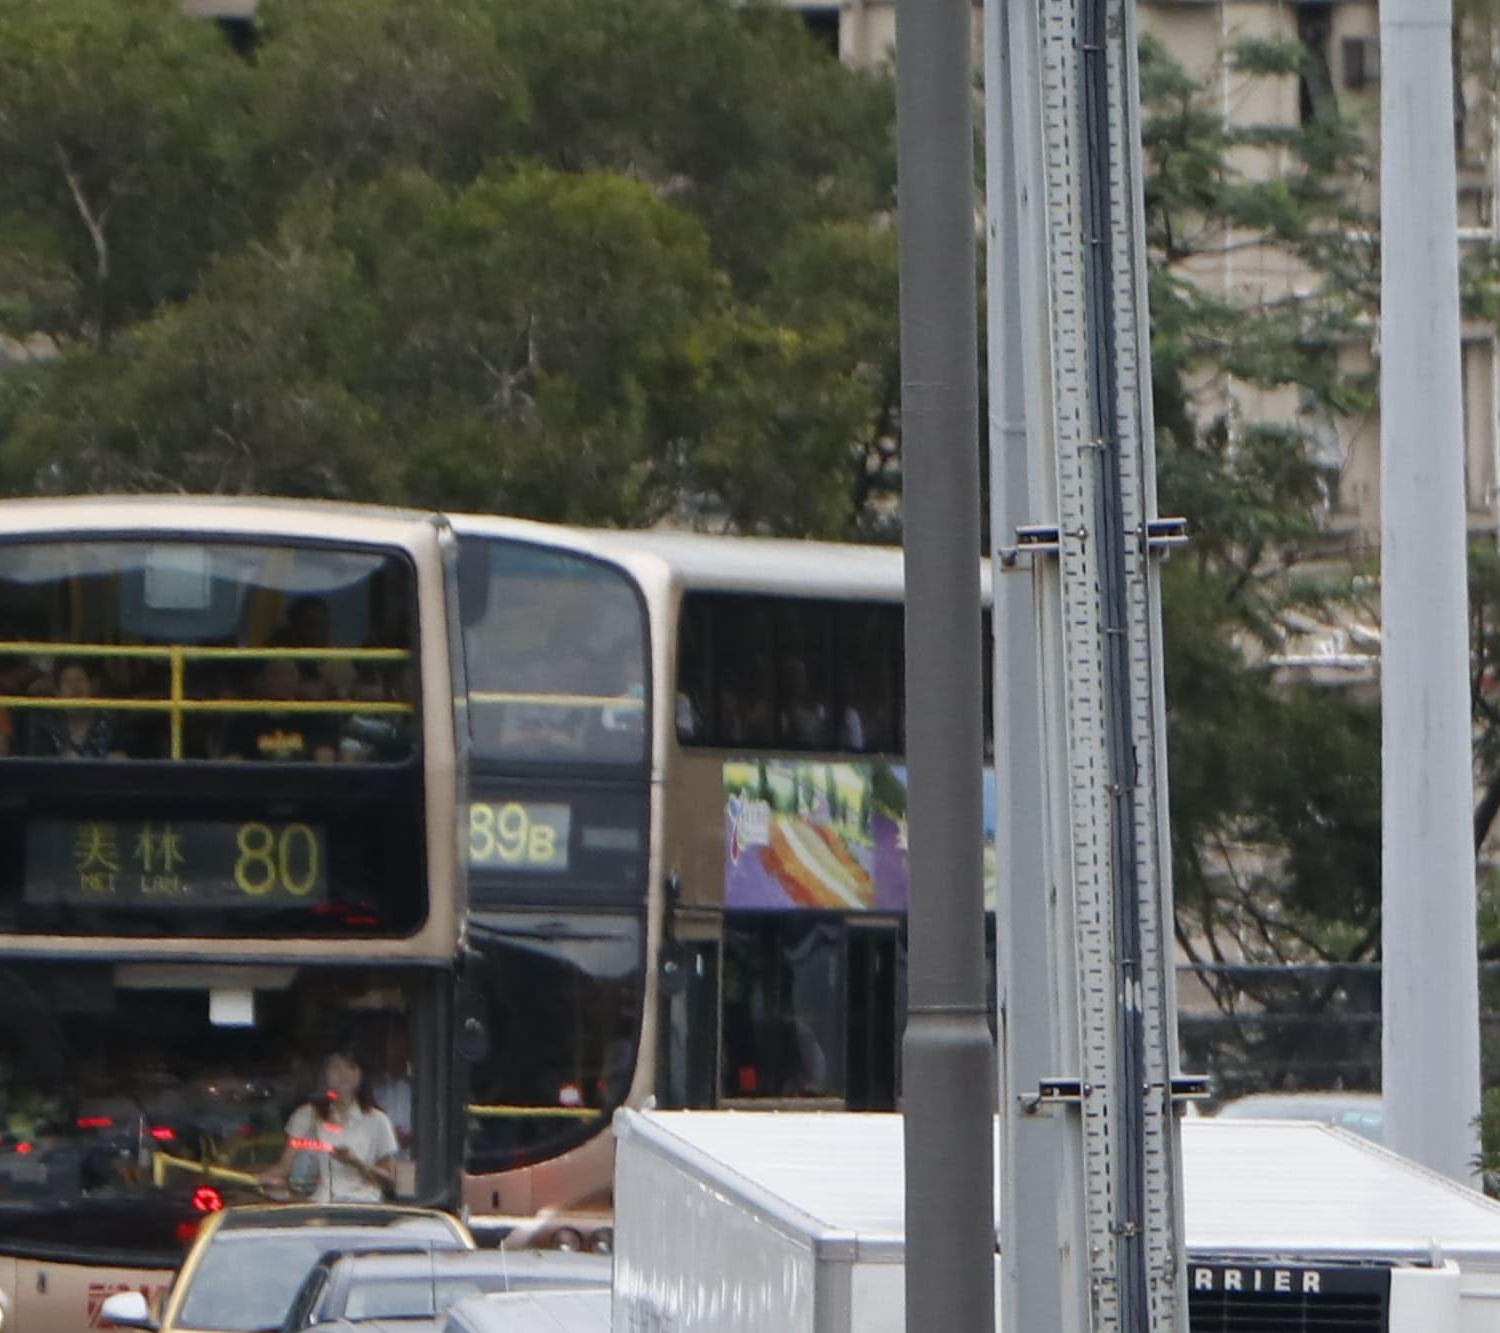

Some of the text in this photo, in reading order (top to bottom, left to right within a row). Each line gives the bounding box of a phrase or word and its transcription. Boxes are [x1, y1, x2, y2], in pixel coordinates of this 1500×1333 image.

[235, 823, 318, 895] 80
[469, 803, 556, 862] 89B
[1194, 1268, 1321, 1294] RRIER
